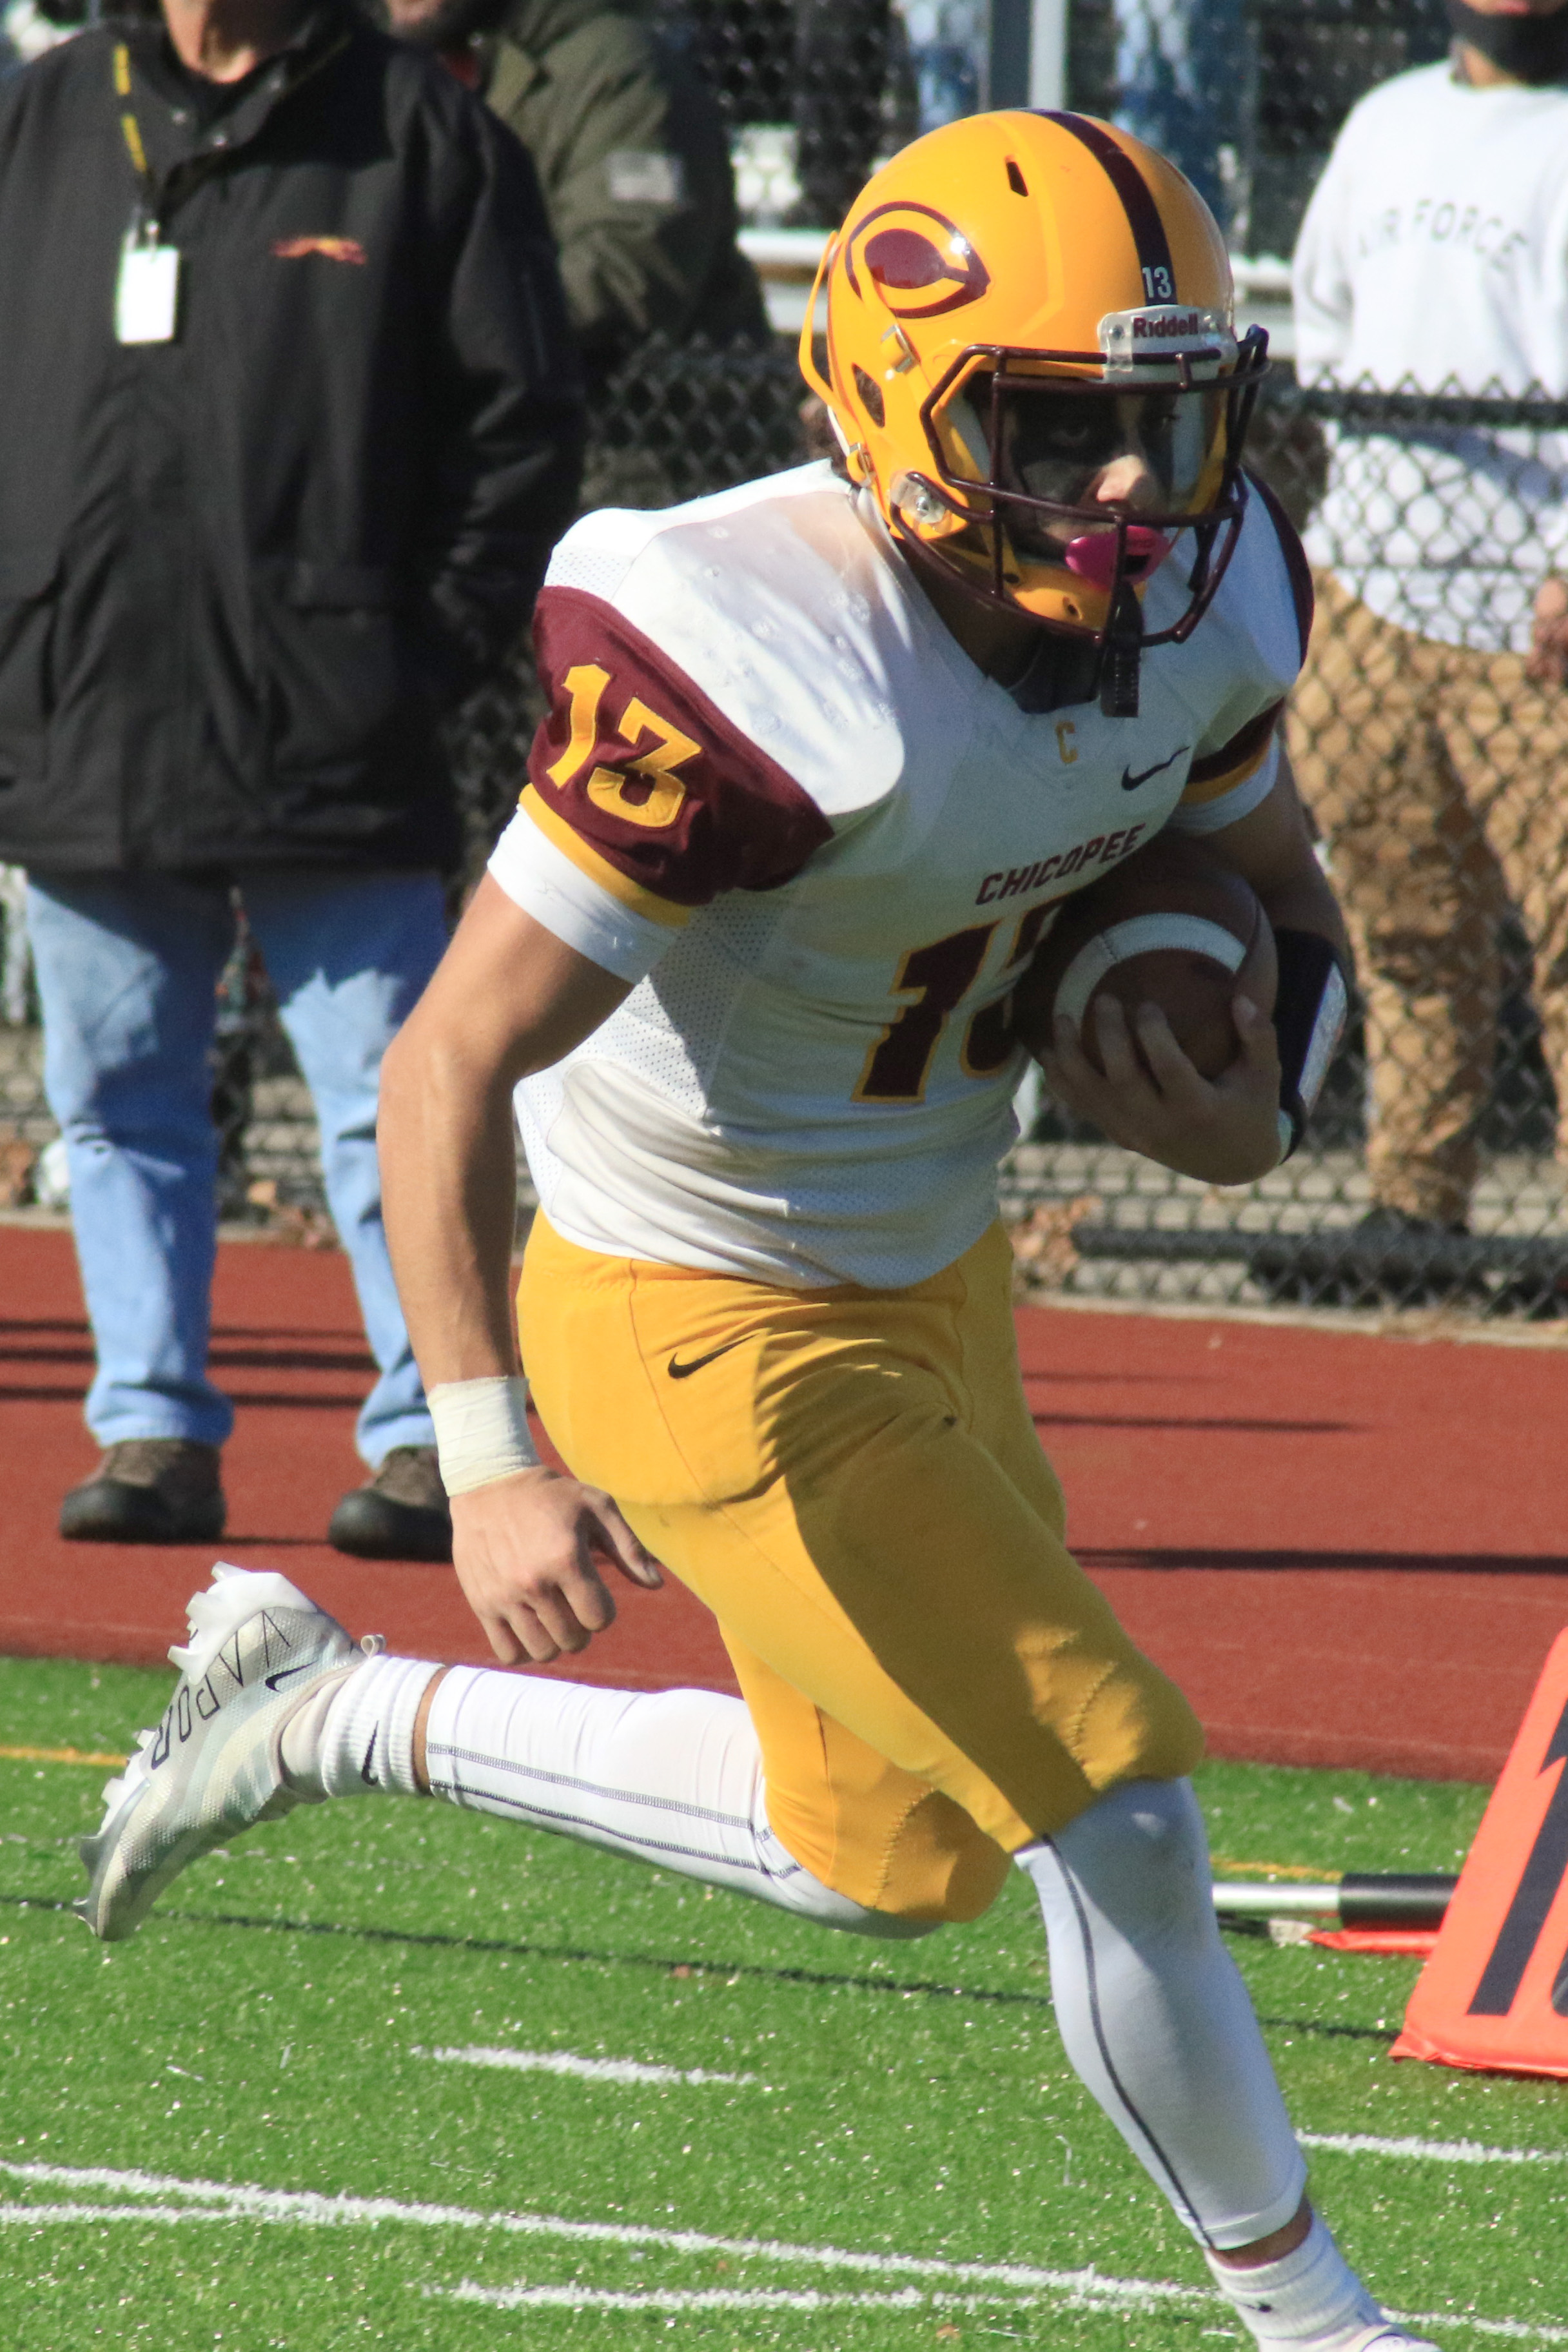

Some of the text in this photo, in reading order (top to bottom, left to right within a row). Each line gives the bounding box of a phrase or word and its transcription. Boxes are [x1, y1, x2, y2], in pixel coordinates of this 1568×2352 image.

[1142, 266, 1173, 299] 13
[1133, 313, 1199, 338] Riddell
[545, 663, 703, 828] 13
[1055, 720, 1079, 764] C
[975, 822, 1146, 906] CHICOPEE
[150, 1609, 291, 1770] VAPOR
[1465, 1694, 1568, 2017] 1
